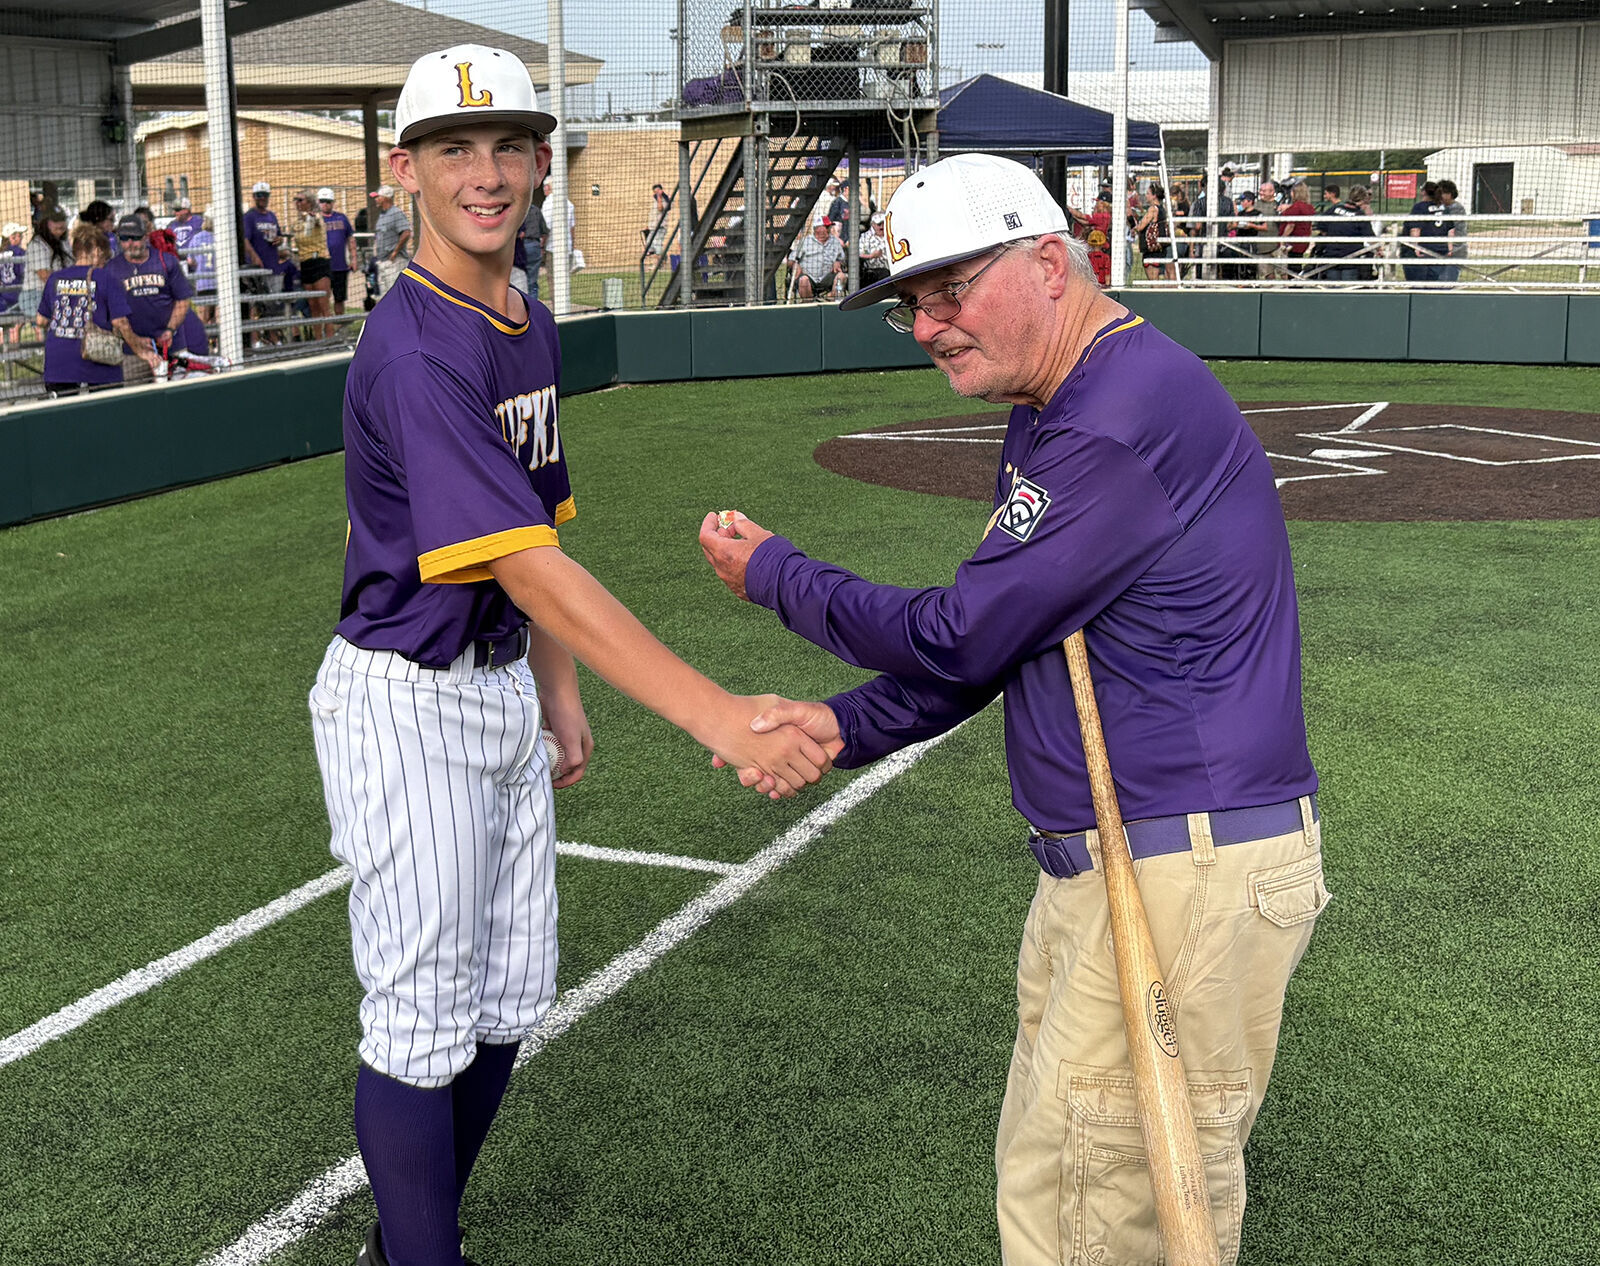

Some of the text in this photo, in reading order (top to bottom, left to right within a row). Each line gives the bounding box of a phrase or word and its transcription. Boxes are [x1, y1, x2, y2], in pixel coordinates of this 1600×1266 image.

[454, 62, 494, 107] L
[885, 211, 912, 264] L
[1153, 988, 1176, 1046] Slugger
